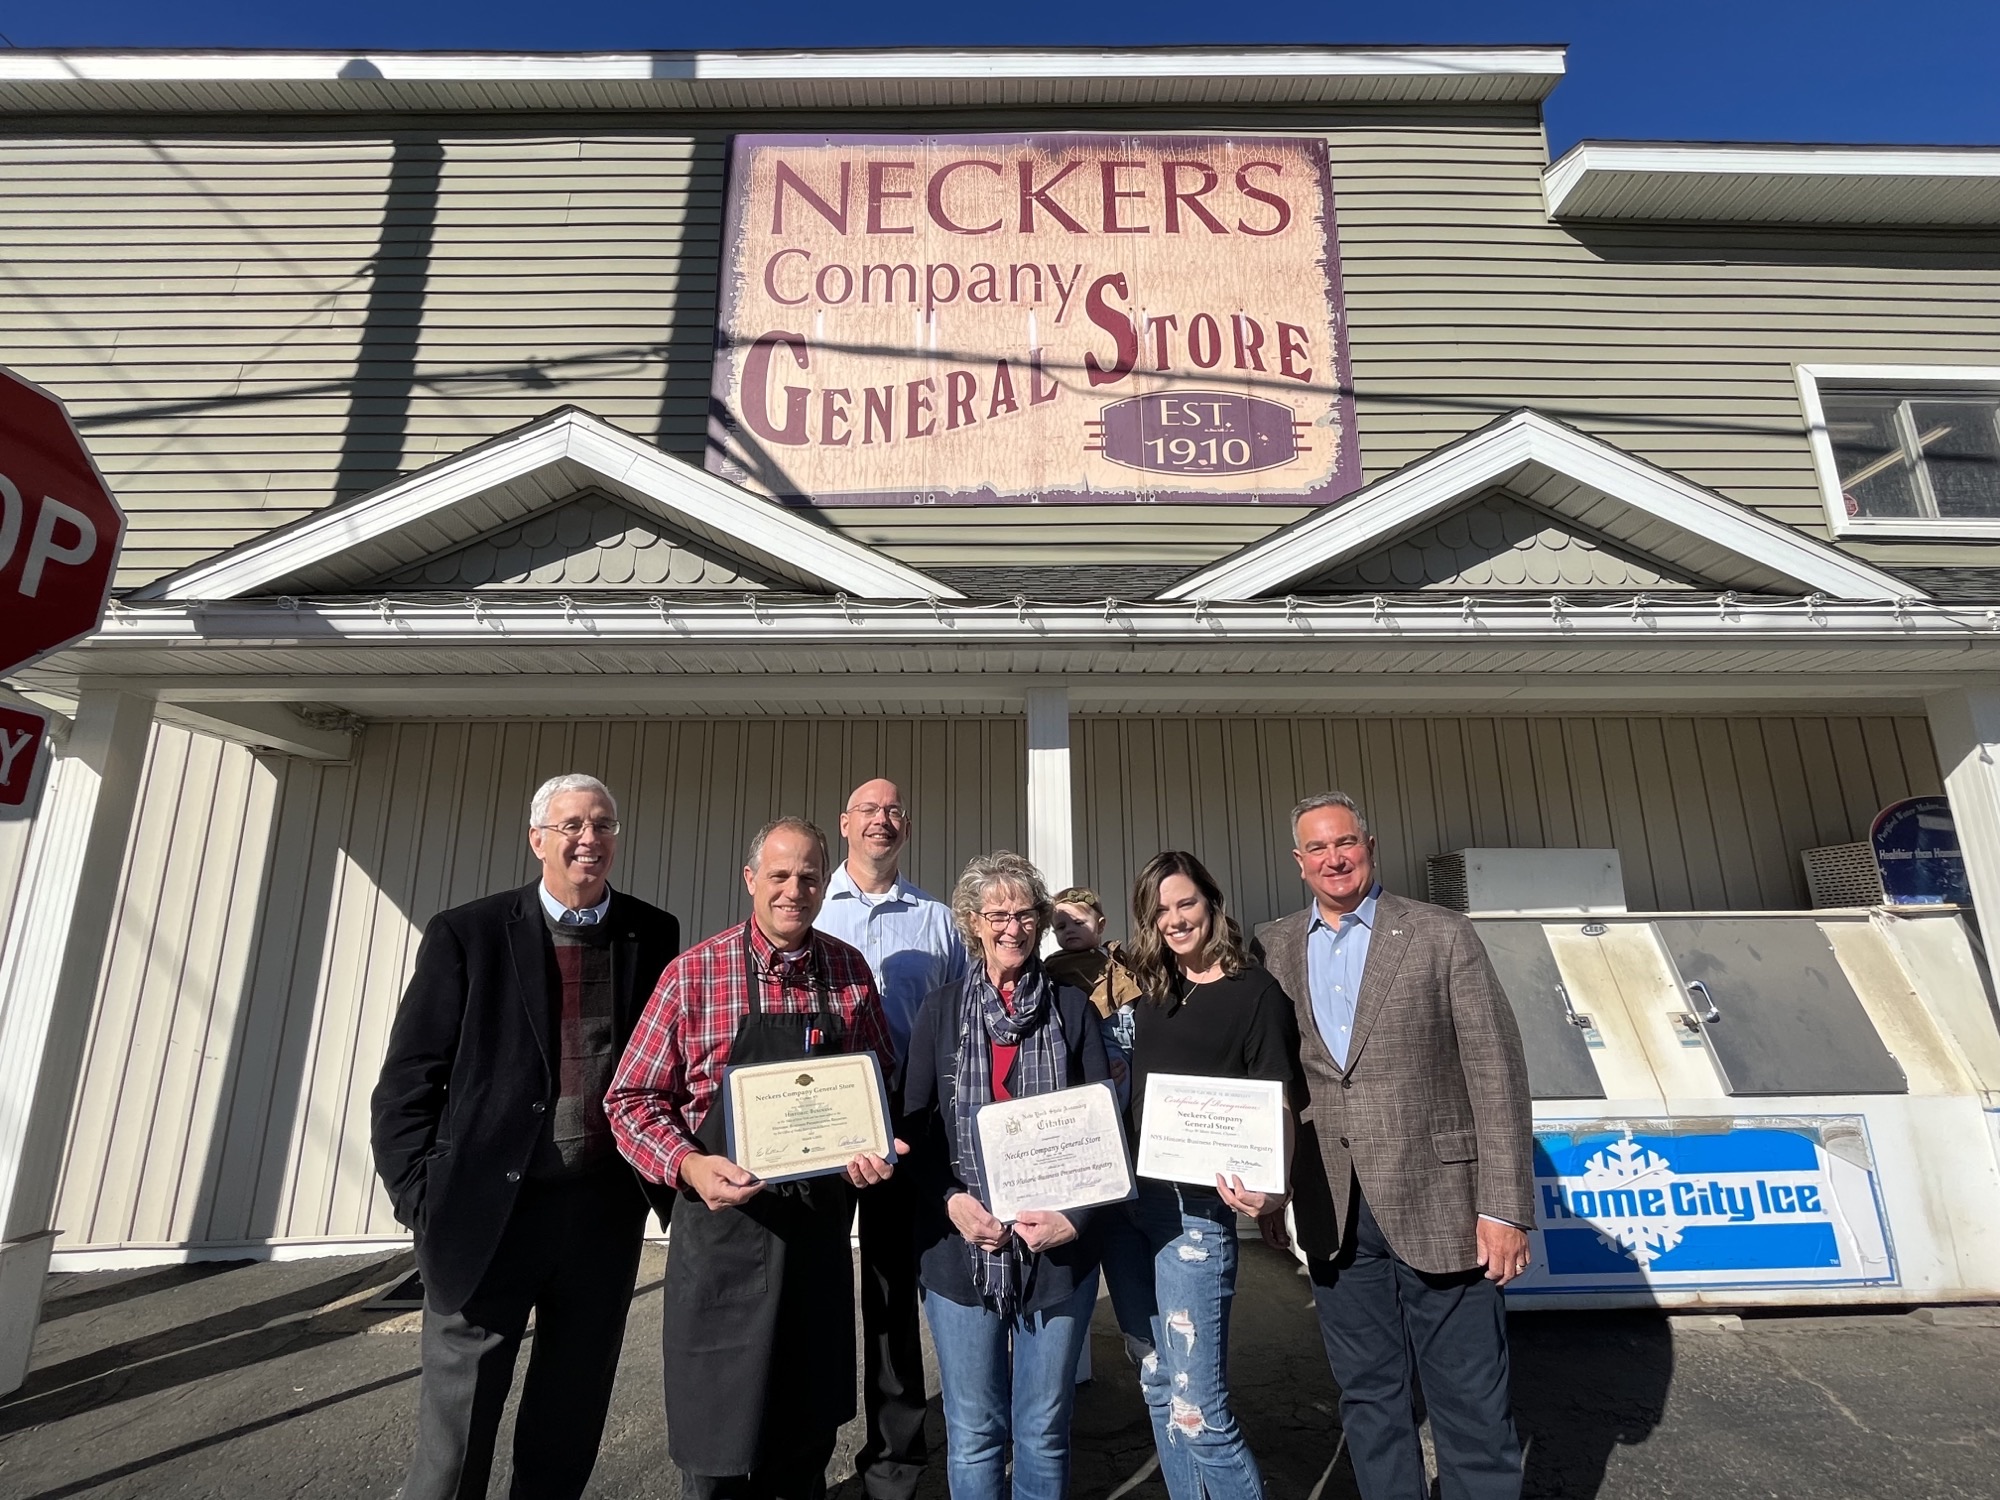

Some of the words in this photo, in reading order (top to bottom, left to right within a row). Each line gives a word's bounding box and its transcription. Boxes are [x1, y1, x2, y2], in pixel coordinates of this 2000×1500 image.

[771, 160, 1293, 236] NECKERS
[764, 248, 1084, 323] Company
[741, 330, 1059, 446] GENERAL
[1084, 272, 1313, 387] STORE
[1148, 439, 1251, 466] 1910
[755, 1093, 782, 1101] Neckers
[783, 1090, 812, 1098] Company
[813, 1085, 838, 1093] General
[1037, 1117, 1076, 1130] Citation
[1177, 1111, 1206, 1120] Neckers
[1208, 1113, 1243, 1124] Company
[1185, 1120, 1214, 1129] General
[1215, 1123, 1235, 1131] Store
[1004, 1150, 1030, 1161] Neckers
[1030, 1143, 1059, 1157] Company
[1060, 1138, 1084, 1151] General
[1085, 1136, 1101, 1145] Store
[1541, 1184, 1666, 1219] Home
[1669, 1181, 1755, 1222] City
[1757, 1180, 1821, 1214] Ice
